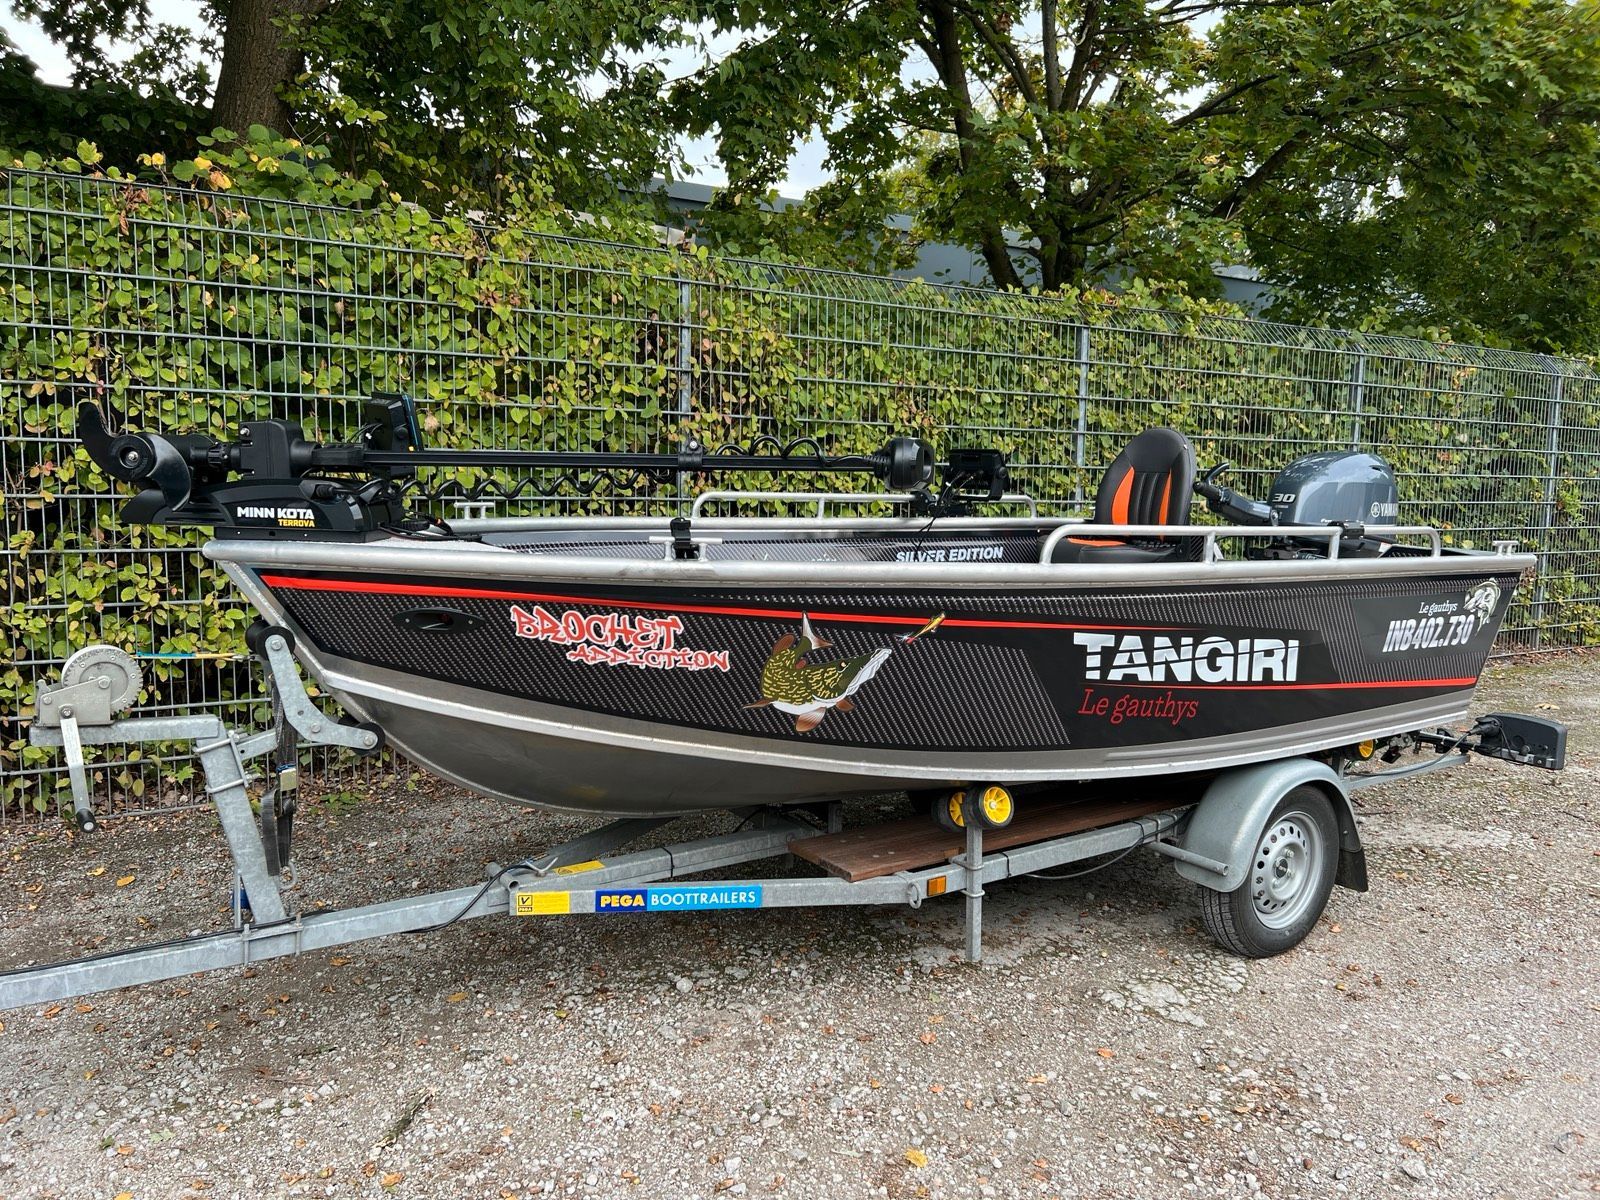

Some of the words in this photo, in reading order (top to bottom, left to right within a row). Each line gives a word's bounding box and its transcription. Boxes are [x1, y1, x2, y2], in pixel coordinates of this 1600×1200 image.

[1272, 493, 1296, 503] 30
[237, 507, 274, 518] MINN
[277, 509, 315, 519] KOTA
[278, 519, 315, 527] TERROVA
[896, 550, 945, 561] SILVER
[948, 547, 1003, 560] EDITION
[1419, 602, 1428, 613] Le
[1428, 600, 1458, 616] gauthys
[510, 605, 684, 648] BROCHET
[1382, 614, 1475, 653] INB402.730
[566, 644, 731, 672] ADDICTION
[1073, 632, 1299, 683] TANGIRI
[1078, 689, 1109, 716] Le
[1110, 691, 1199, 726] gauthys
[600, 894, 645, 908] PEGA
[651, 891, 756, 906] BOOTTRAILERS
